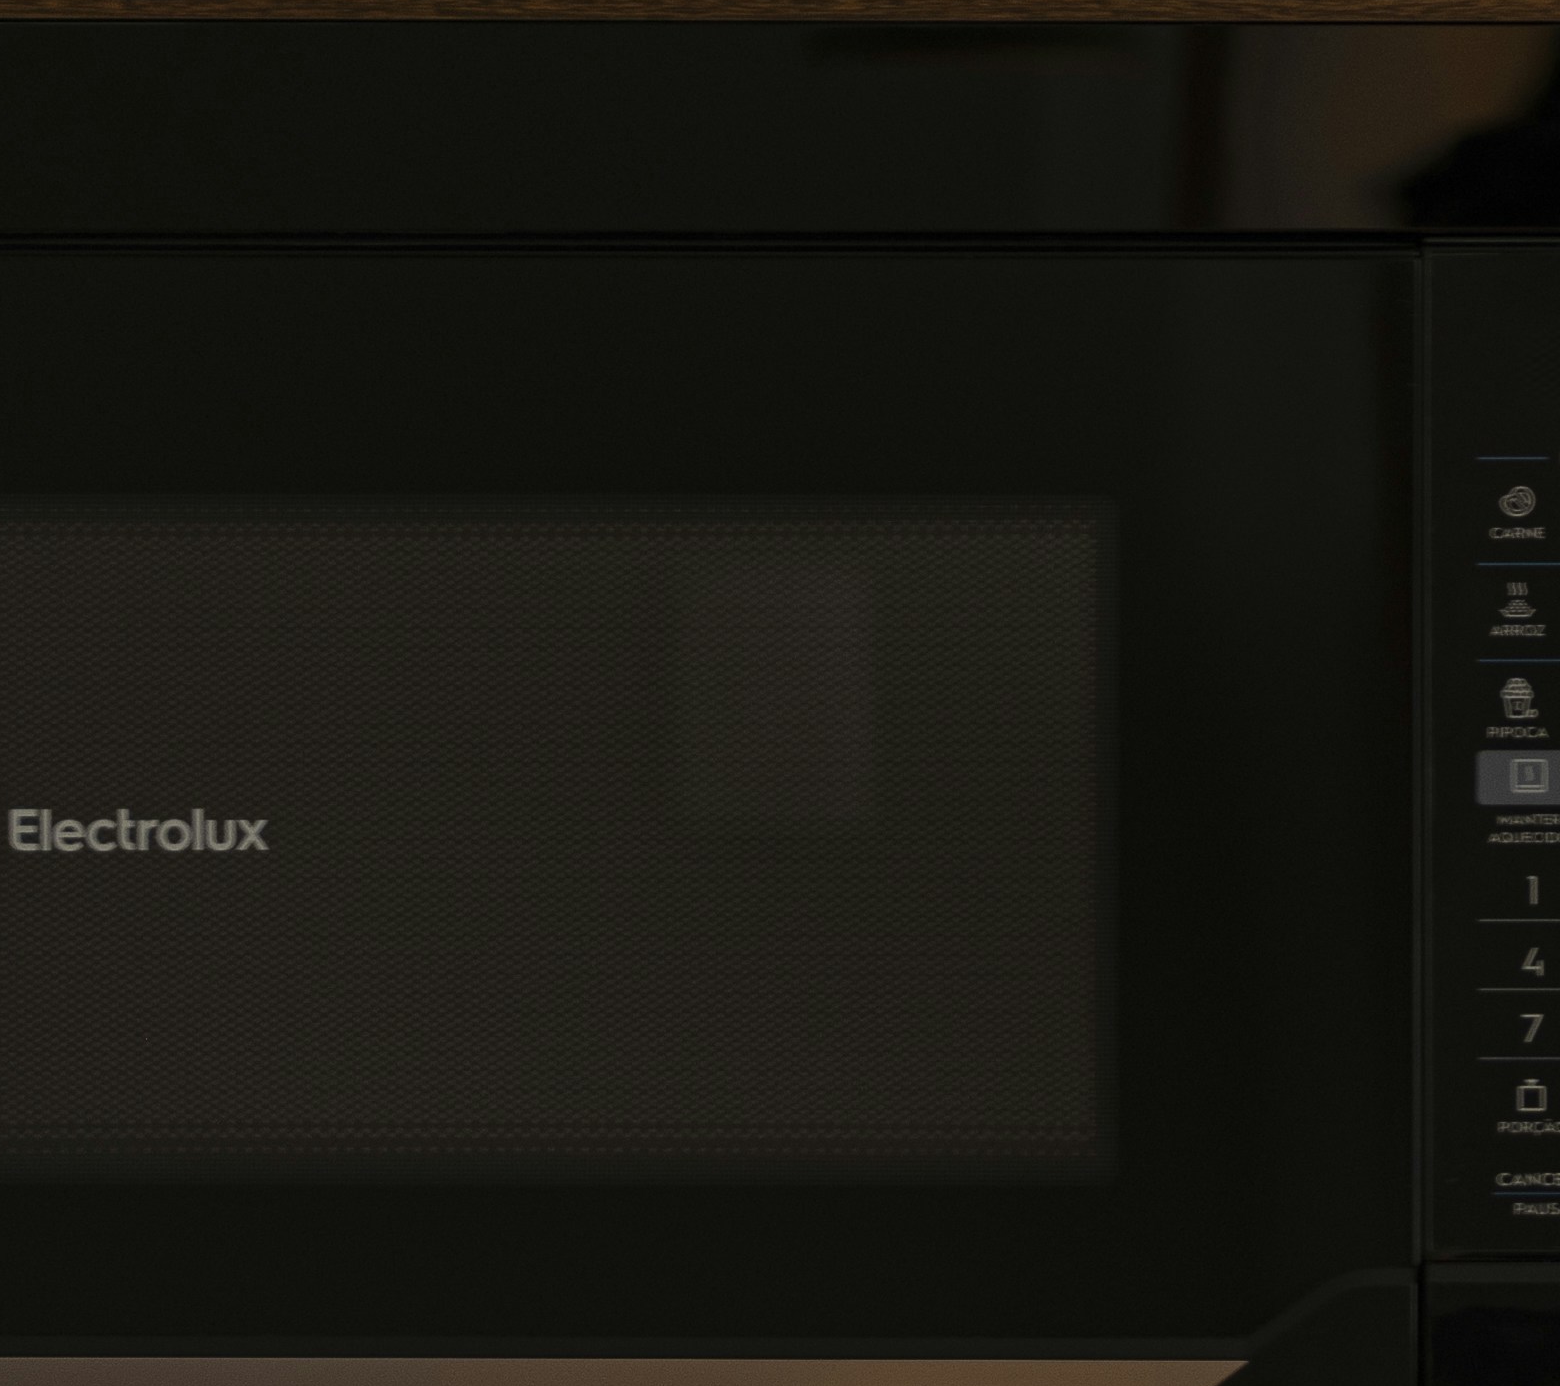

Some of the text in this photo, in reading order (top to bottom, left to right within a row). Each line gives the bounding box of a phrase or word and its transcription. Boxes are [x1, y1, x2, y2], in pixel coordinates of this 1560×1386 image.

[1489, 526, 1545, 540] CARNE
[1489, 623, 1546, 637] ARROZ
[1485, 725, 1549, 739] PIPOCA
[8, 807, 269, 853] Electrolux
[1526, 874, 1539, 905] 1
[1521, 947, 1545, 976] 4
[1520, 1013, 1544, 1043] 7
